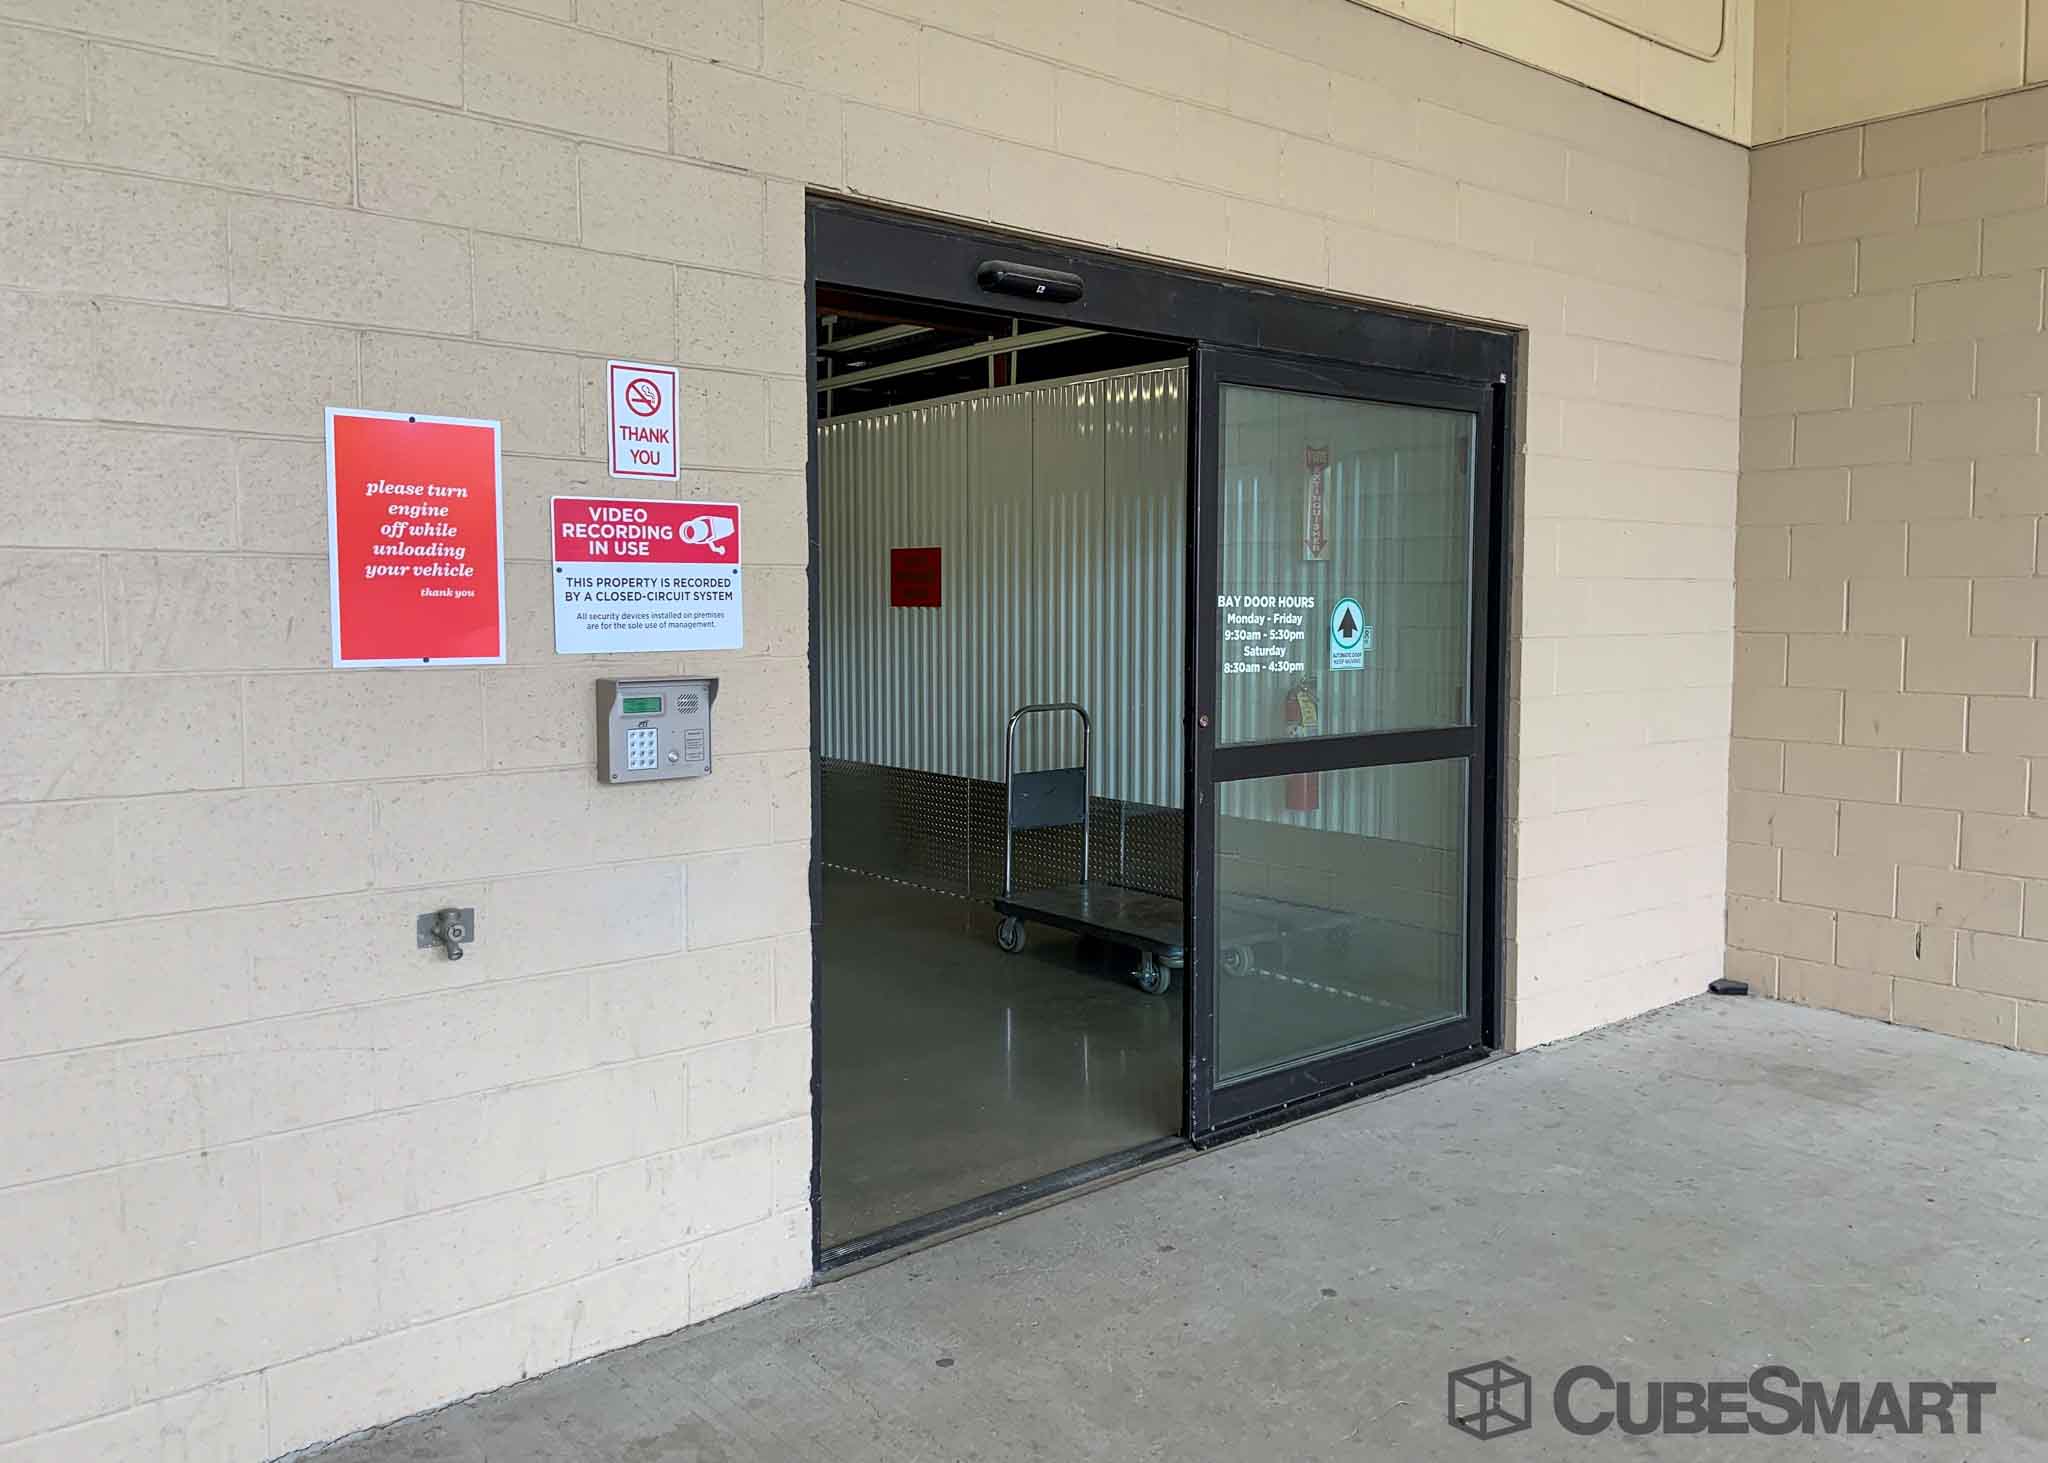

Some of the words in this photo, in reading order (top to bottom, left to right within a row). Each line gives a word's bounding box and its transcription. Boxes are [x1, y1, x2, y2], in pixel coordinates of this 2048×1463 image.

[620, 425, 670, 444] THANK
[630, 449, 661, 466] YOU
[366, 480, 424, 496] please
[427, 484, 468, 498] turn
[388, 502, 449, 518] engine
[588, 506, 648, 523] VIDEO
[380, 521, 408, 538] off
[410, 522, 458, 537] while
[561, 523, 673, 540] RECORDING
[373, 542, 466, 560] unloading
[588, 540, 608, 555] IN
[614, 542, 650, 556] USE
[365, 562, 411, 578] your
[413, 564, 474, 578] vehicle
[566, 577, 593, 588] THIS
[596, 577, 657, 588] PROPERTY
[660, 578, 671, 588] IS
[673, 578, 732, 588] RECORDED
[420, 588, 454, 598] thank
[454, 589, 476, 599] you
[565, 591, 582, 602] BY
[584, 591, 593, 602] A
[596, 591, 691, 602] CLOSED-CIRCUIT
[694, 590, 733, 602] SYSTEM
[1218, 596, 1242, 607] BAY
[1244, 596, 1276, 608] DOOR
[1278, 597, 1315, 608] HOURS
[576, 612, 588, 620] All
[589, 612, 620, 622] security
[622, 612, 650, 621] devices
[651, 612, 682, 620] installed
[694, 611, 725, 621] premises
[1227, 614, 1265, 626] Monday
[1274, 614, 1303, 626] Friday
[600, 622, 612, 630] for
[613, 622, 628, 630] the
[628, 622, 643, 630] sole
[658, 622, 666, 630] of
[1225, 630, 1261, 641] 9:30am
[1269, 630, 1304, 642] 5:30pm
[1244, 646, 1286, 658] Saturday
[1224, 662, 1260, 674] 8:30am
[1268, 661, 1304, 674] 4:30pm
